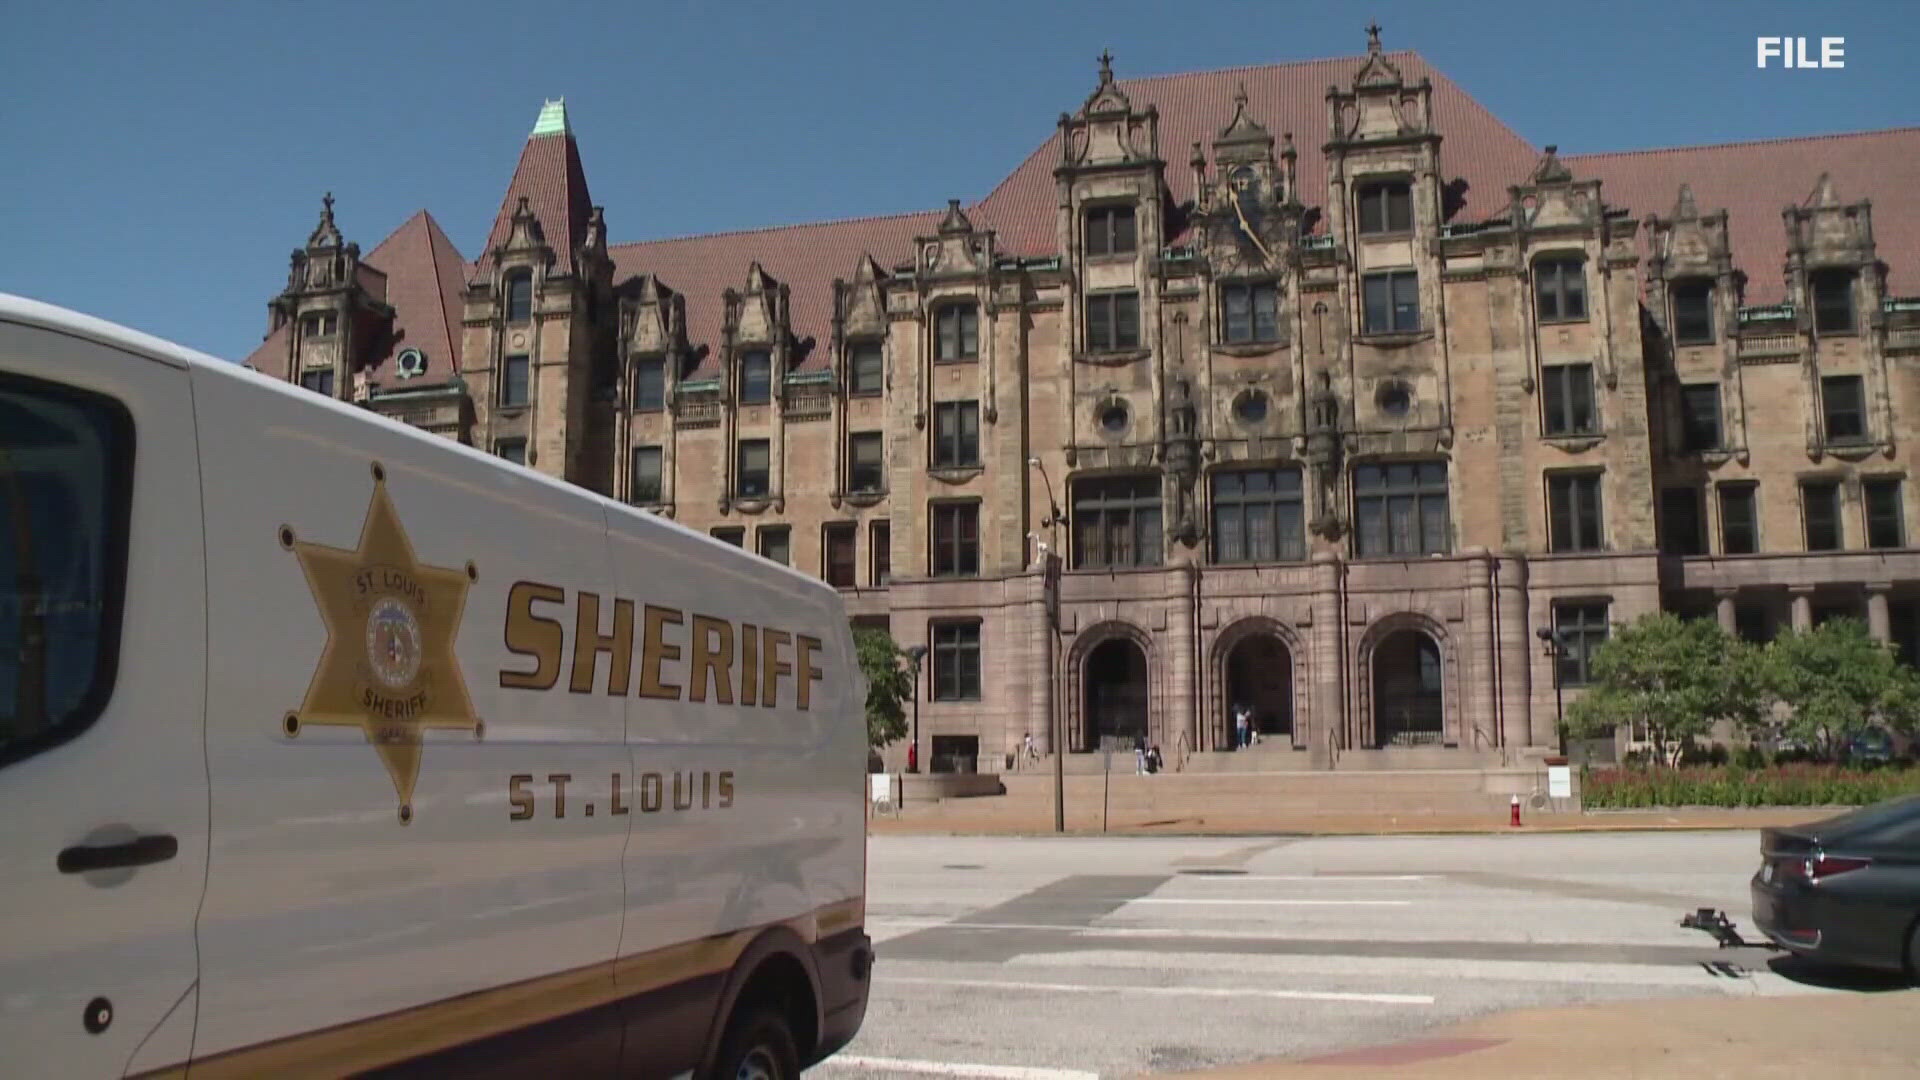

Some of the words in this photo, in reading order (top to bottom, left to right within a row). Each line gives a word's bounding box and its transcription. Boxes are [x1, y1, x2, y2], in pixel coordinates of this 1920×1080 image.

[383, 568, 426, 605] LOUIS
[500, 580, 823, 712] SHERIFF
[363, 687, 428, 719] SHERIFF
